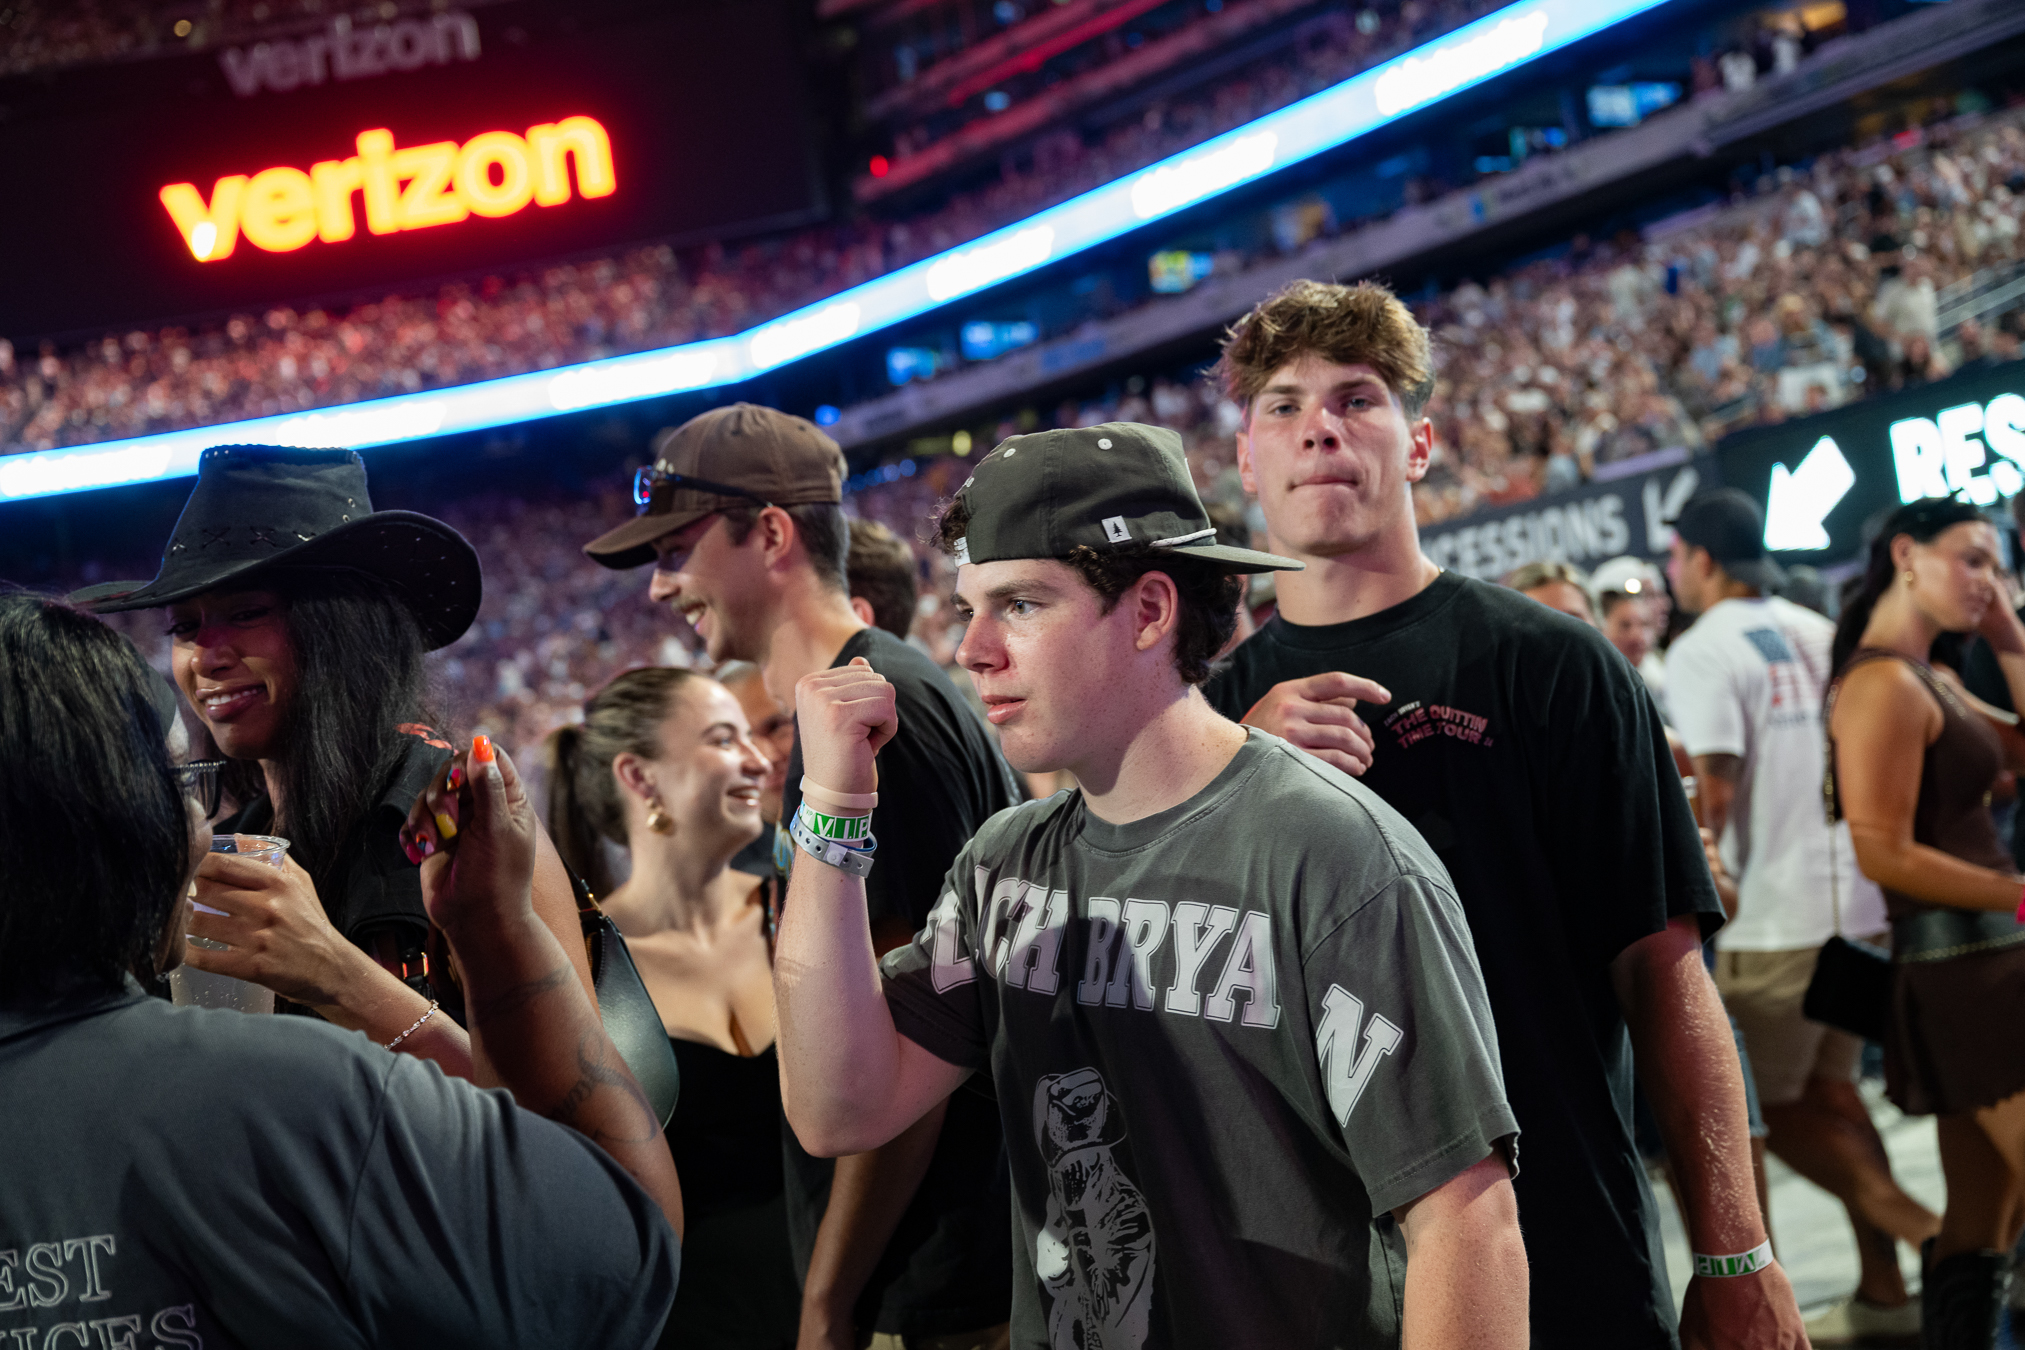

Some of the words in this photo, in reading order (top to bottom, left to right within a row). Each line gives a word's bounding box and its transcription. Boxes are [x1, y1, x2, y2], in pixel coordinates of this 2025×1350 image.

[218, 11, 482, 96] verizon
[160, 116, 616, 261] verizon
[1889, 392, 2025, 507] RES
[1423, 494, 1629, 577] CESSIONS
[1392, 708, 1428, 734] THE
[1429, 704, 1488, 733] QUITTIN
[1397, 723, 1434, 748] TIME
[1436, 721, 1482, 744] TOUR
